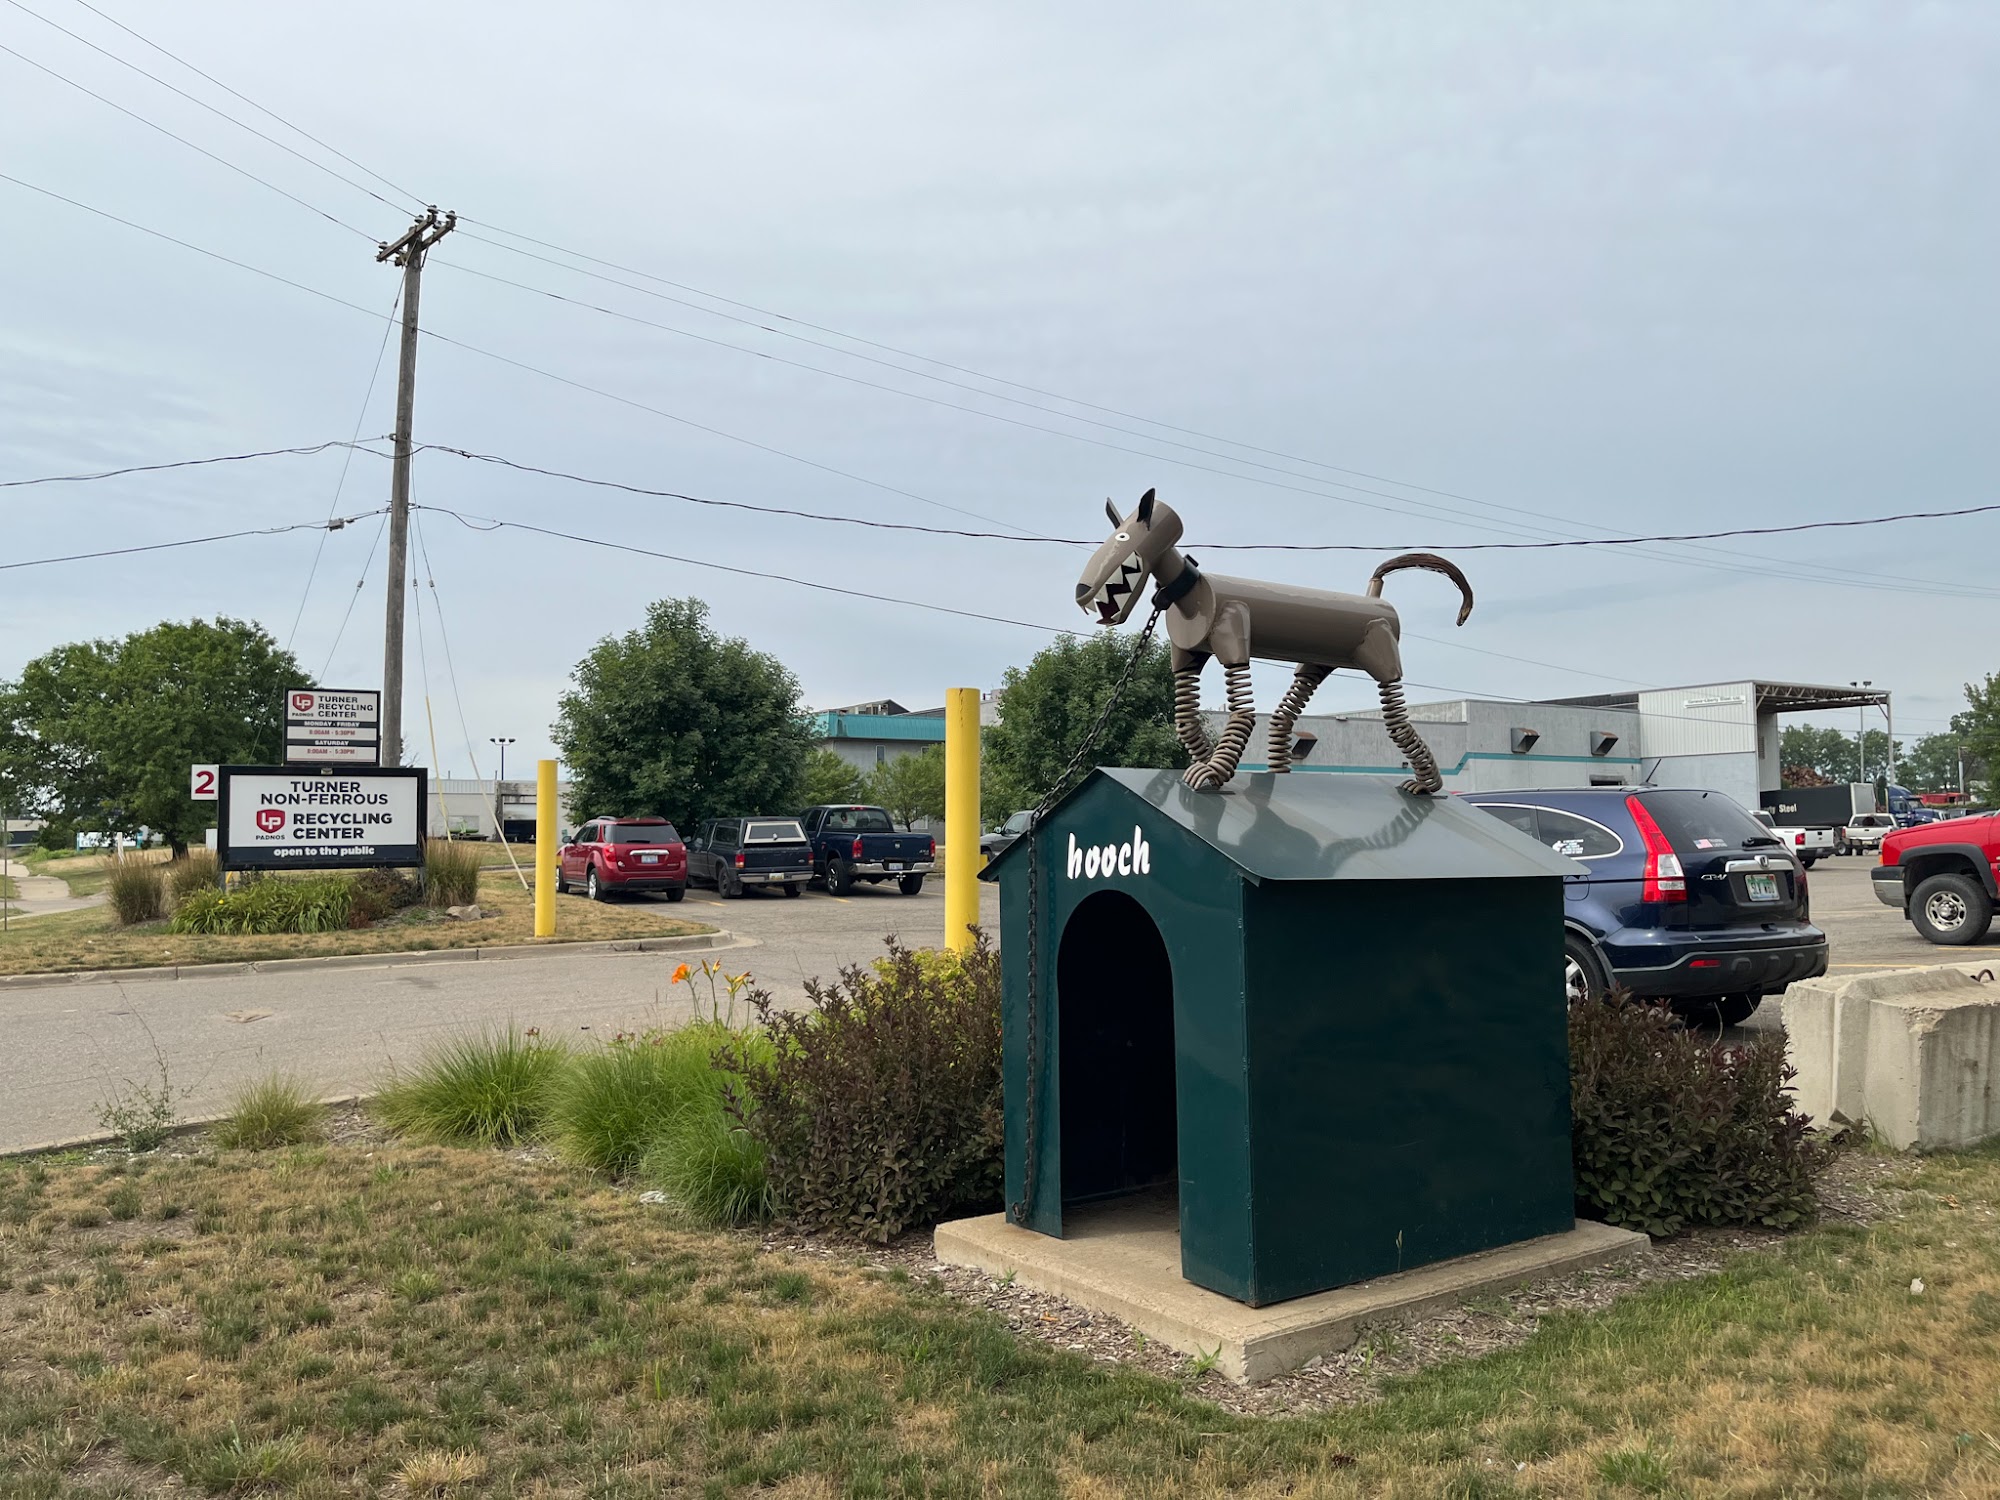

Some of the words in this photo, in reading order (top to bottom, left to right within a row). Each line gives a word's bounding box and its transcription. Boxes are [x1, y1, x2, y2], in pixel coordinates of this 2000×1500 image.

[318, 695, 358, 703] TURNER
[318, 703, 374, 711] RECYCLING
[318, 710, 357, 718] CENTER
[194, 770, 215, 794] 2
[290, 781, 361, 793] TURNER
[260, 793, 388, 805] NON-FERROUS
[1778, 803, 1797, 813] Steel
[293, 813, 393, 825] RECYCLING
[292, 827, 365, 840] CENTER
[273, 847, 303, 858] open
[305, 847, 318, 856] to
[319, 846, 339, 856] the
[340, 846, 375, 857] public
[1066, 824, 1150, 880] hooch
